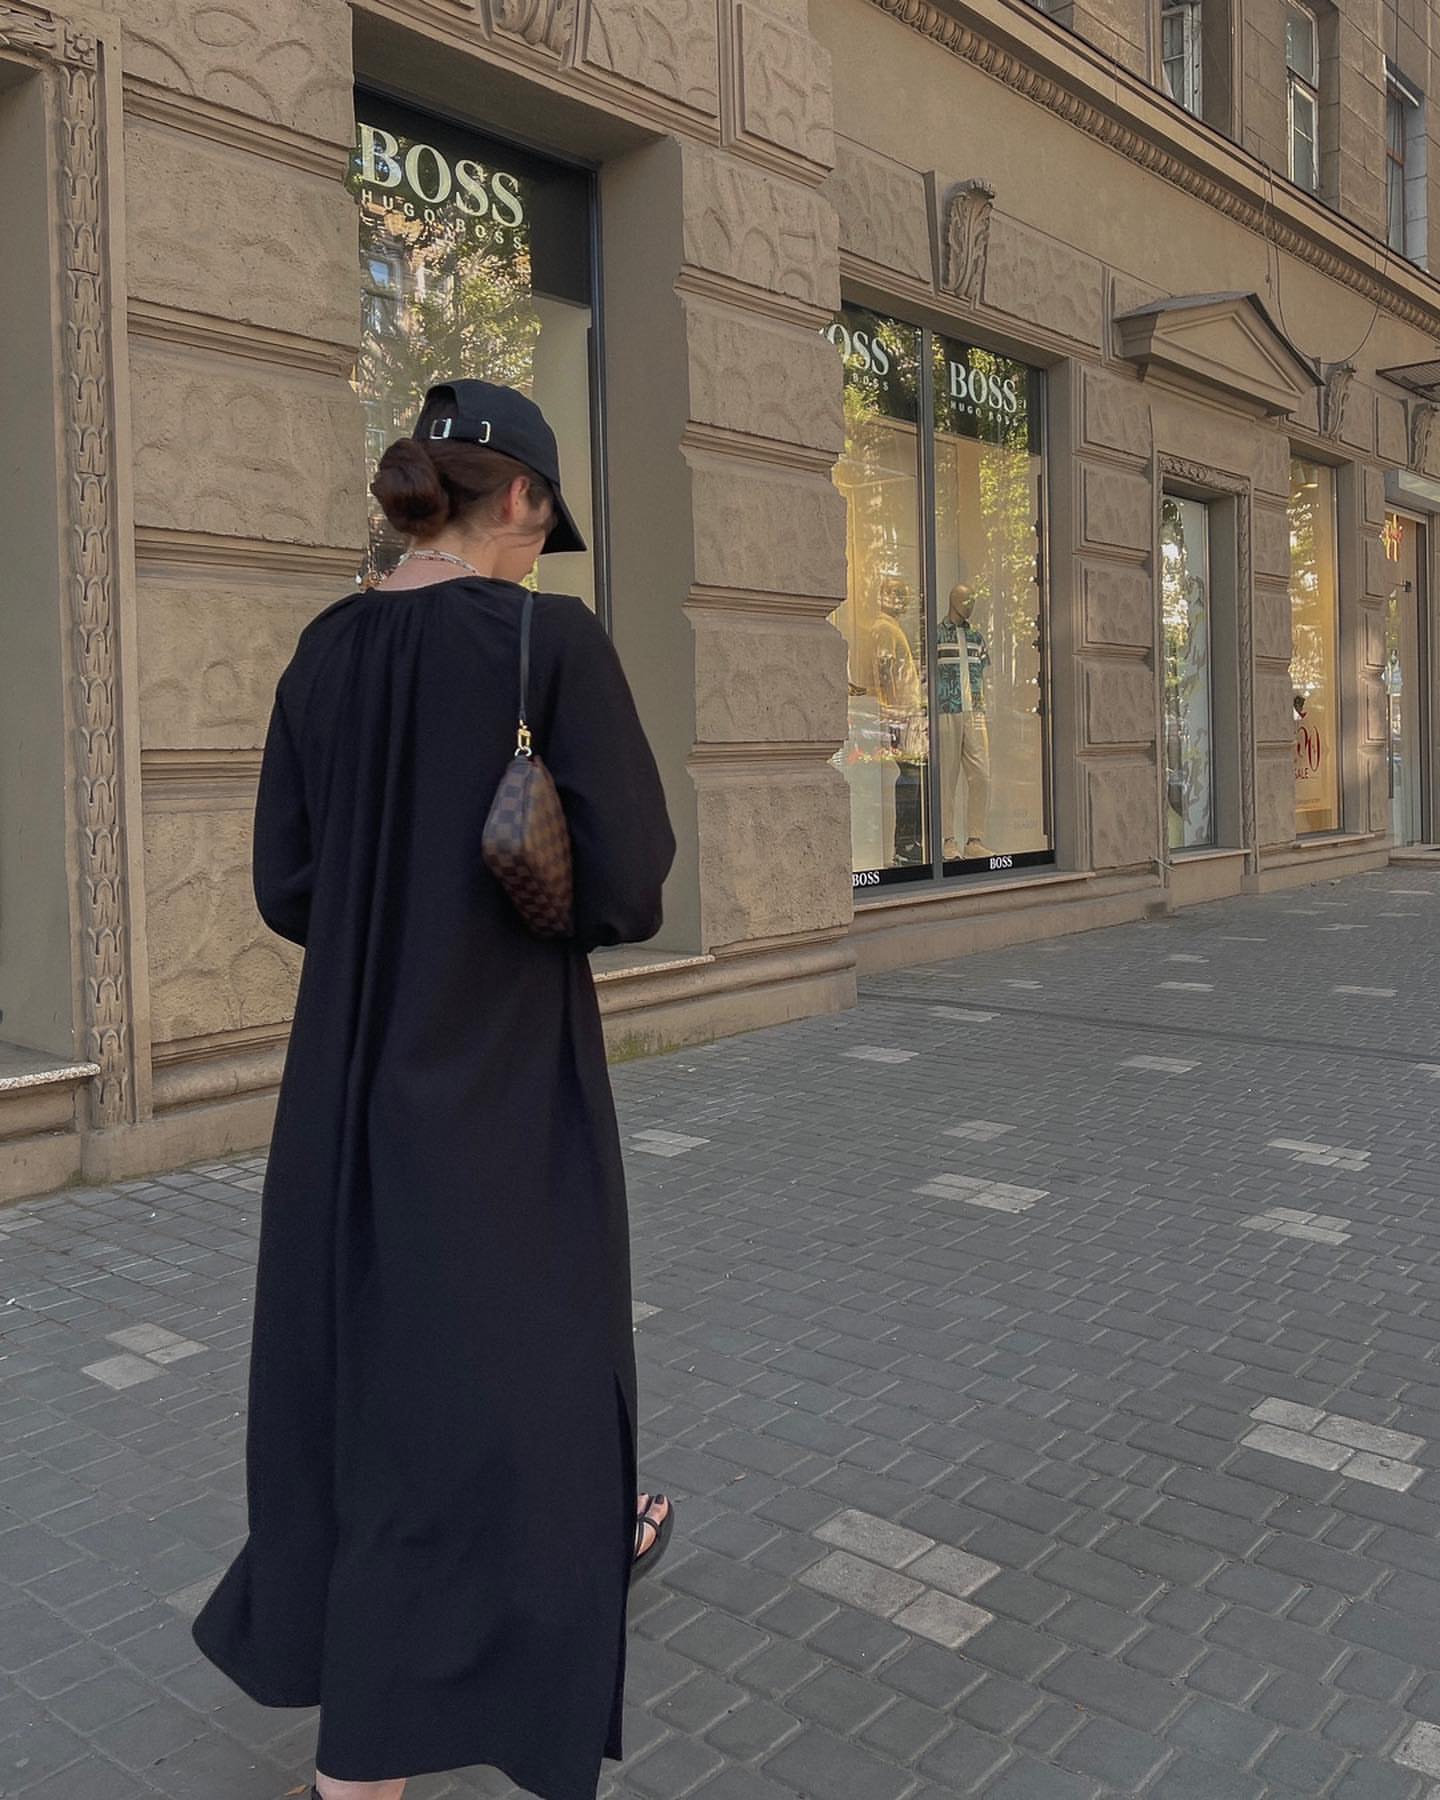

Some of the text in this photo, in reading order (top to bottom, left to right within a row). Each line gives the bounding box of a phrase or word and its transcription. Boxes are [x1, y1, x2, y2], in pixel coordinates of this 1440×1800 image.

[358, 123, 523, 228] BOSS
[362, 189, 522, 250] HUGO BOSS
[827, 324, 889, 376] OSS
[951, 361, 1017, 413] BOSS
[951, 400, 982, 417] HUGO
[852, 871, 880, 887] BOSS
[990, 855, 1013, 870] BOSS
